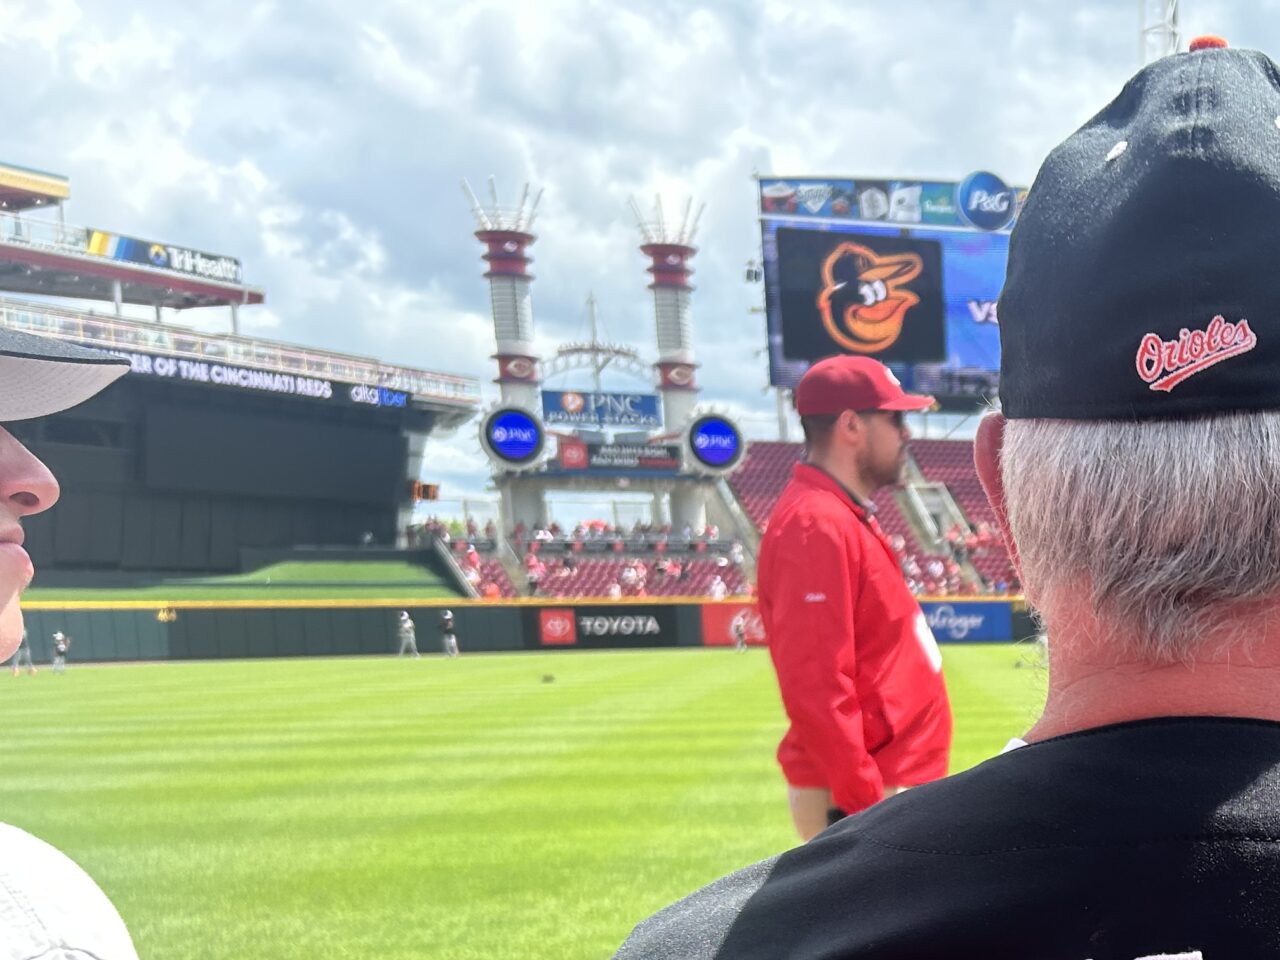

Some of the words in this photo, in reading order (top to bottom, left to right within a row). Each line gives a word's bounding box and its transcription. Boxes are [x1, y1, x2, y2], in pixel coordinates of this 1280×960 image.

[969, 189, 1009, 212] P&G
[165, 245, 242, 280] TriHealth
[1136, 314, 1257, 384] Orioles
[177, 359, 209, 382] THE
[210, 364, 295, 394] CINCINNATI
[295, 376, 333, 399] REDS
[590, 393, 642, 413] PNC
[580, 616, 661, 636] TOYOTA
